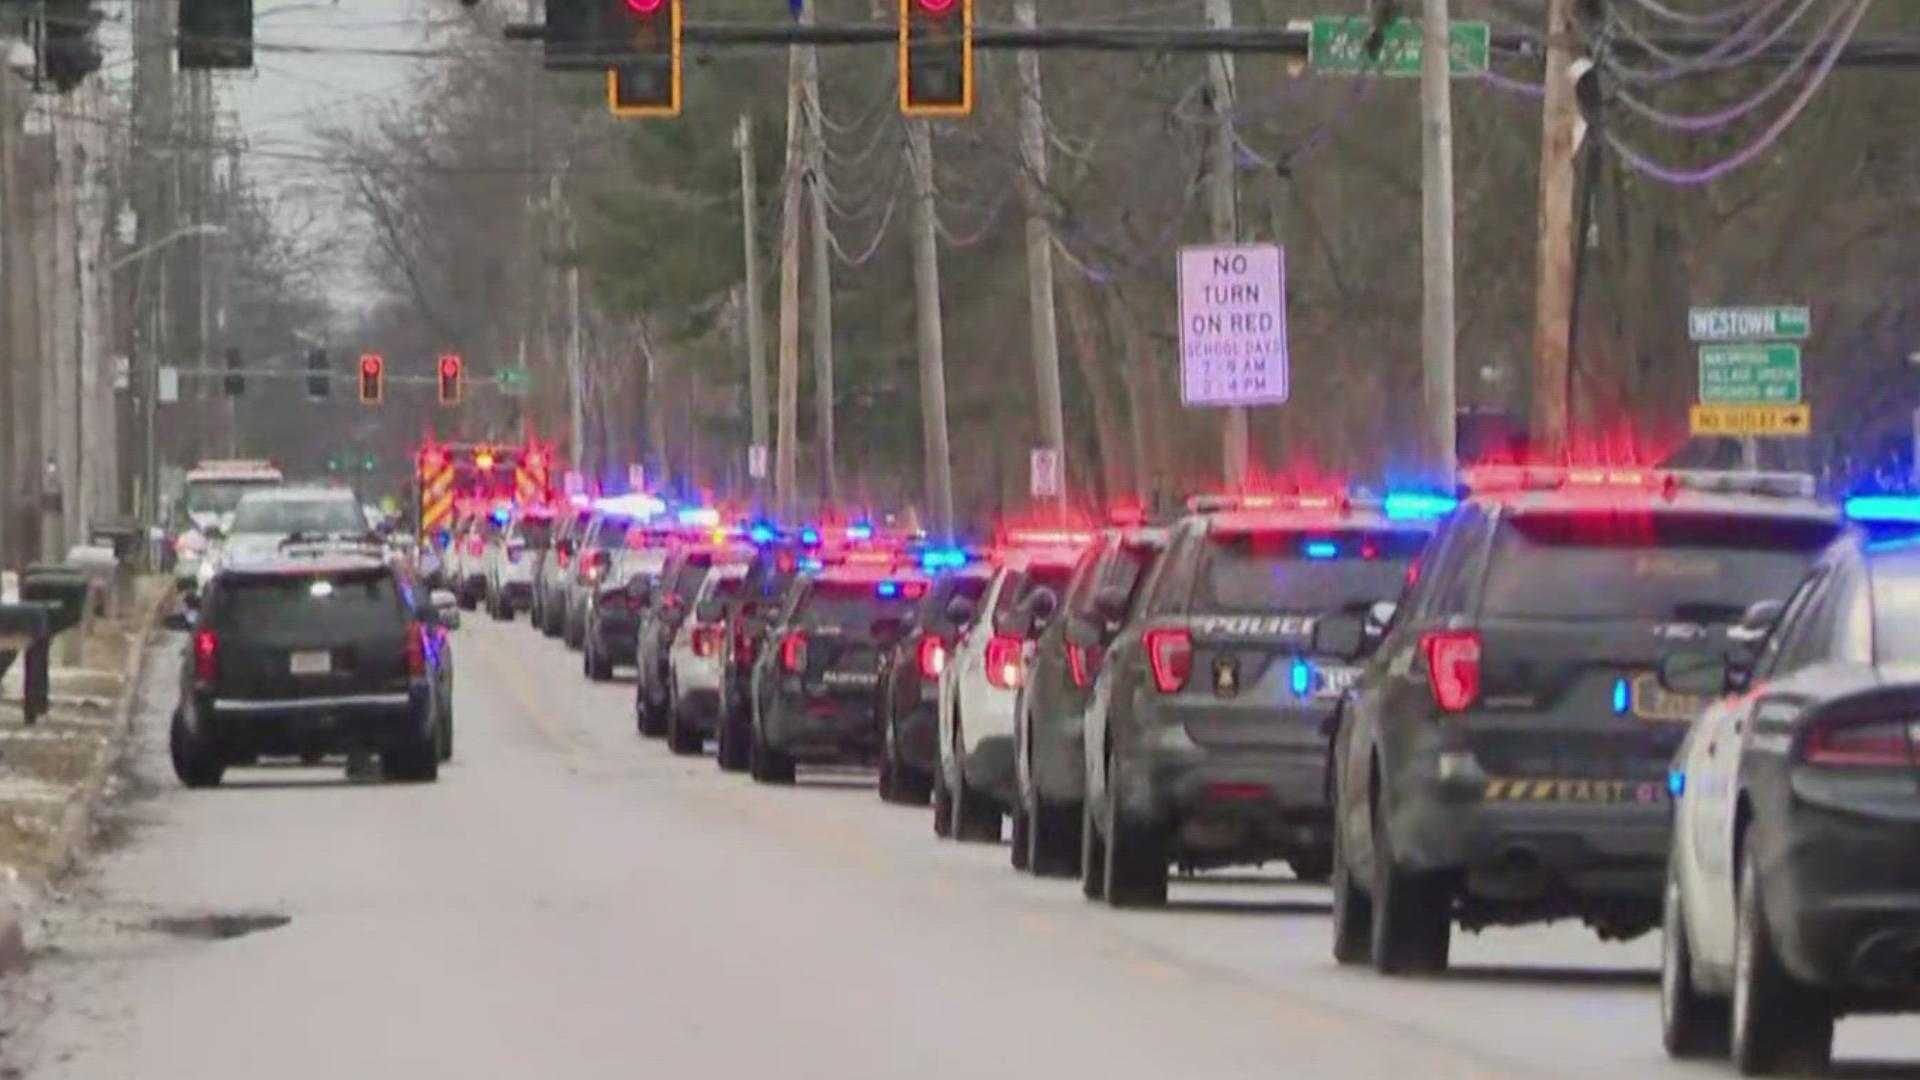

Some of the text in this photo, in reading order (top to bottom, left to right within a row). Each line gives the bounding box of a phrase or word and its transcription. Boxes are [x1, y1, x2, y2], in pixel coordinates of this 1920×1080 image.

[1213, 255, 1247, 275] NO
[1205, 285, 1259, 305] TURN
[1192, 313, 1273, 335] ON RED
[1691, 311, 1775, 335] WESTOWN
[1188, 341, 1238, 358] SCHOOL
[1245, 359, 1266, 373] AM
[1245, 377, 1266, 392] PM
[1203, 616, 1318, 634] POLICE
[1557, 780, 1624, 800] EAST
